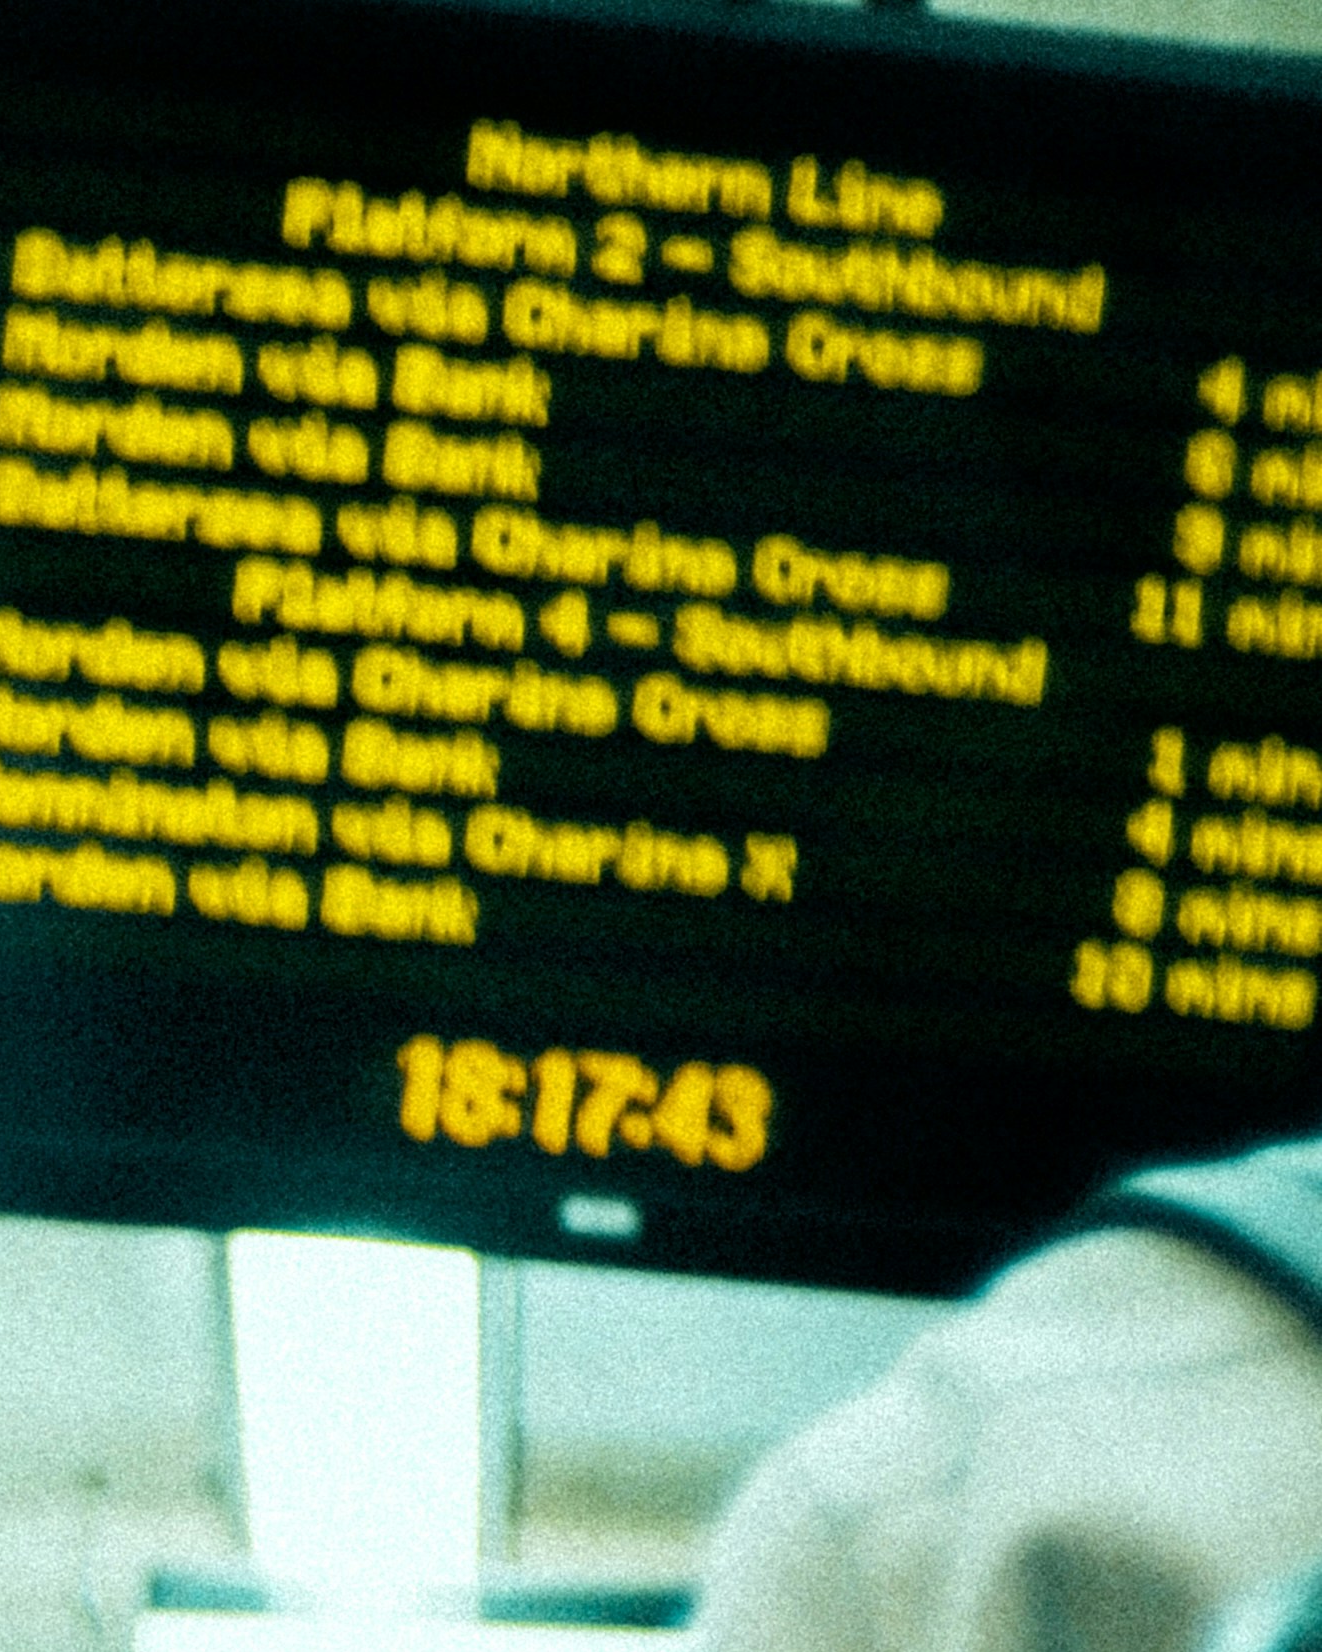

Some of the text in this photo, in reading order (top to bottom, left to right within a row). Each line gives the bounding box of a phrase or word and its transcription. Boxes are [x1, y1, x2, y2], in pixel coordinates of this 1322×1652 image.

[278, 176, 581, 279] Platform
[588, 209, 651, 287] 2
[725, 223, 1109, 335] Southbound
[463, 121, 947, 241] Northern Line
[8, 226, 357, 333] Battersea
[363, 271, 493, 347] via
[499, 275, 774, 375] Charing
[781, 308, 987, 398] Cross
[1195, 357, 1249, 426] 4
[253, 334, 383, 412] via
[388, 341, 555, 430] Bank
[244, 409, 373, 487] via
[378, 417, 545, 504] Bank
[228, 552, 529, 654] Platform
[535, 587, 595, 660] 4
[669, 599, 1051, 708] Southbound
[332, 494, 462, 572] via
[467, 502, 741, 600] Charing
[748, 532, 953, 622] Cross
[1127, 574, 1206, 650] 11
[204, 710, 334, 787] via
[337, 715, 503, 801] Bank
[1123, 797, 1178, 868] 4
[213, 633, 343, 712] via
[347, 640, 622, 740] Charing
[628, 670, 833, 760] Cross
[1144, 726, 1188, 799] 1
[328, 793, 456, 870] via
[460, 800, 733, 899] Charing
[737, 832, 801, 904] X
[184, 853, 313, 933] via
[316, 861, 482, 947] Bank
[1162, 953, 1319, 1031] mins
[393, 1032, 776, 1174] 18:17:43
